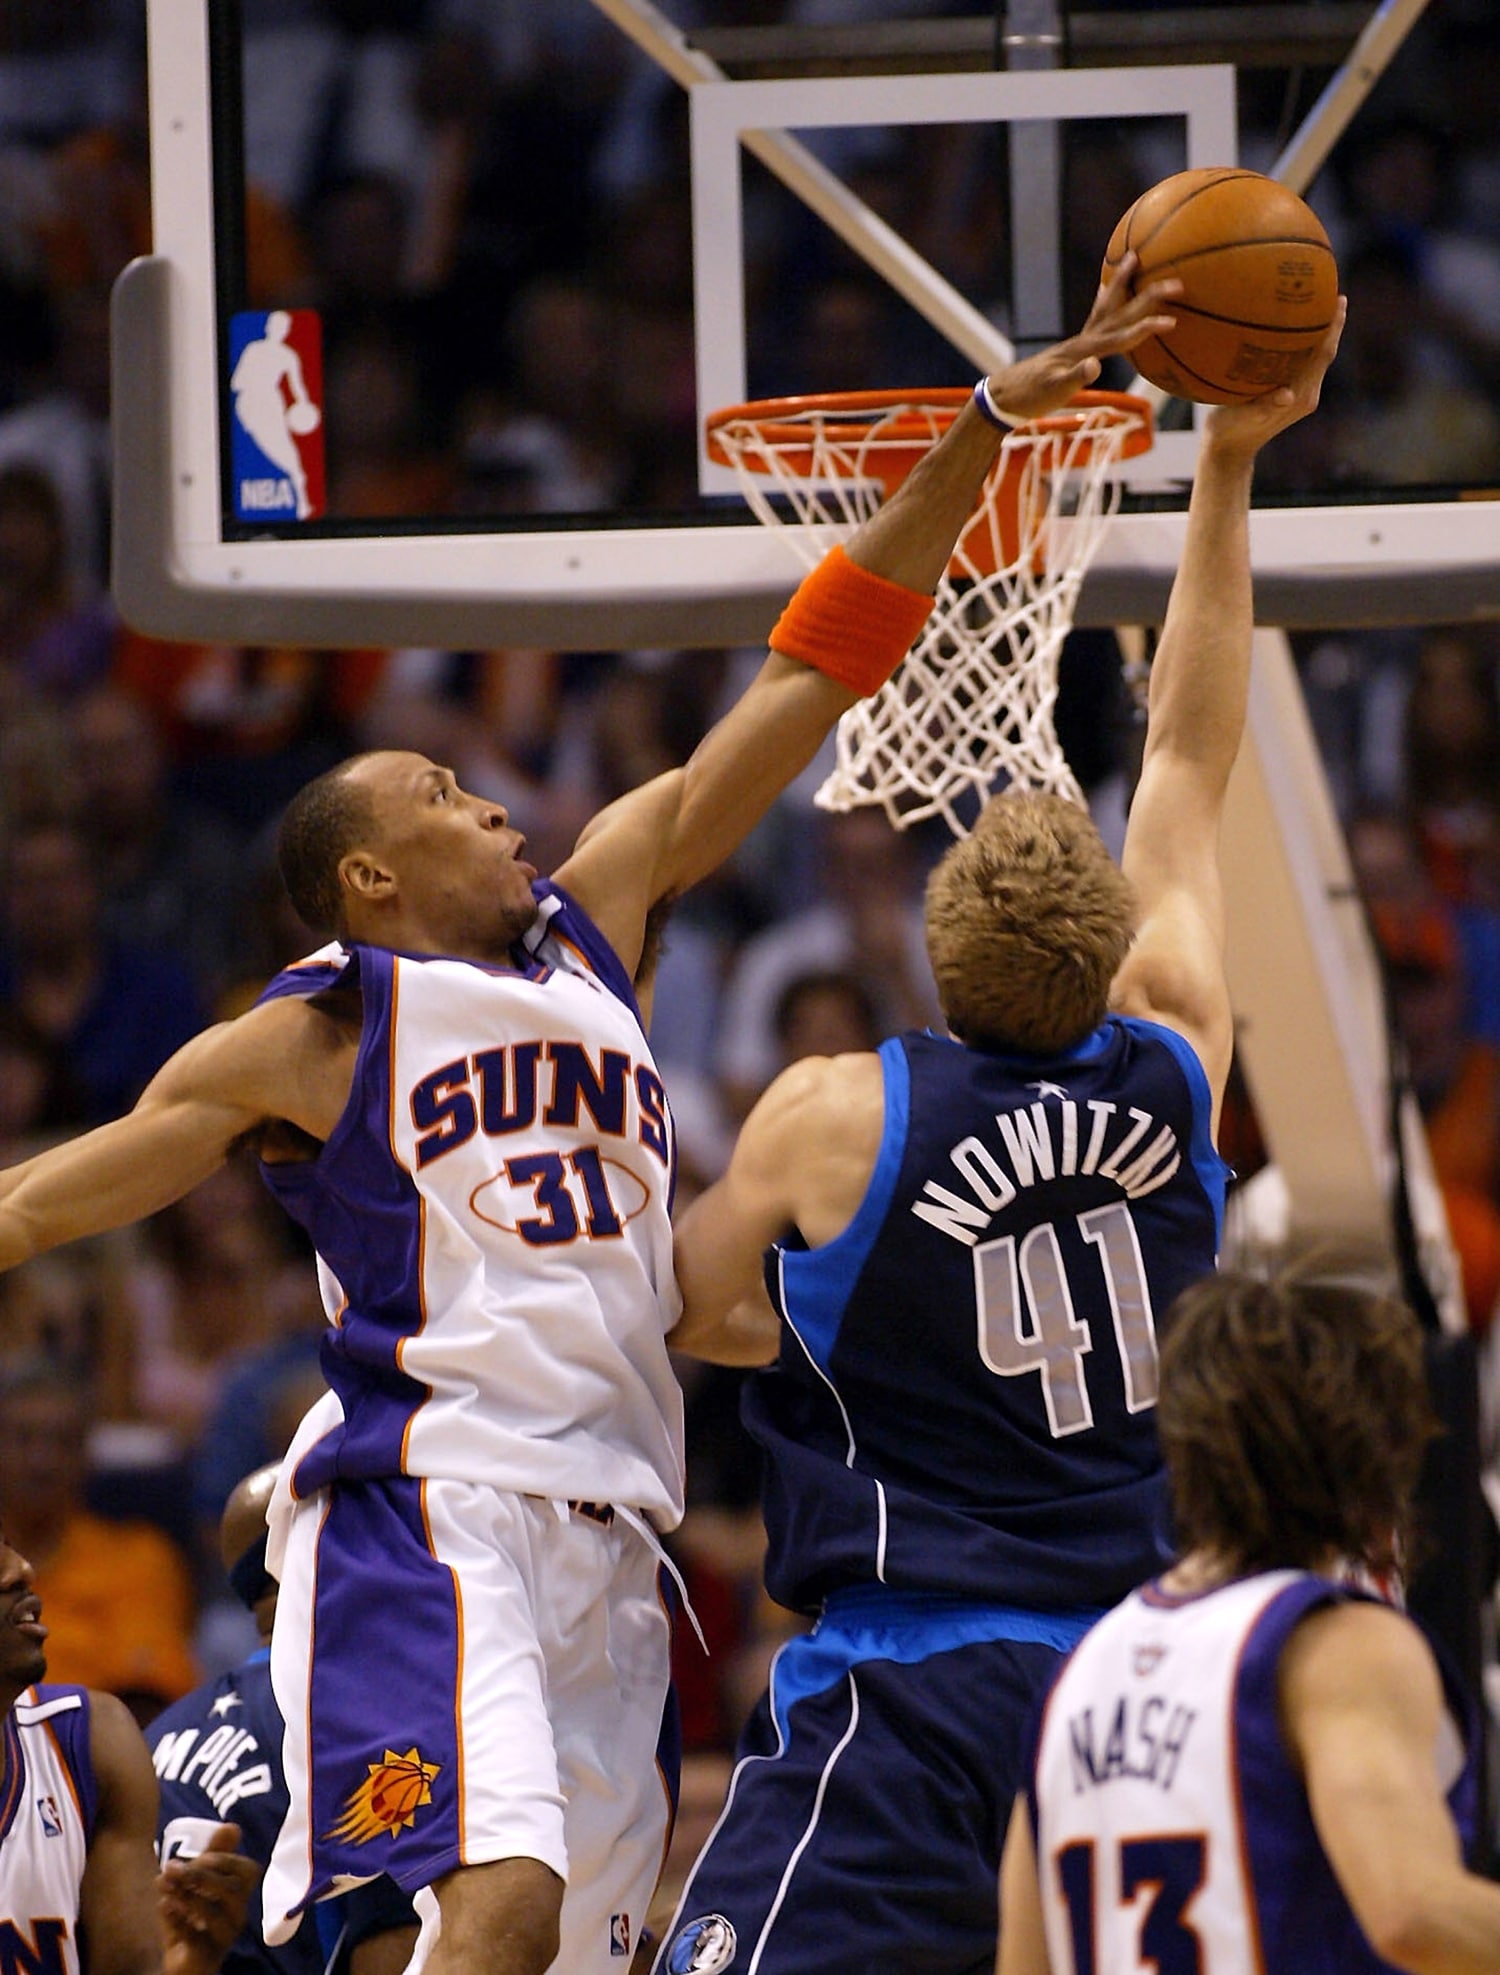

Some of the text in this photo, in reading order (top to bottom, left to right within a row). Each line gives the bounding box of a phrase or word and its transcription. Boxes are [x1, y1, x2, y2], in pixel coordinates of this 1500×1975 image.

[241, 477, 295, 510] NBA
[409, 1039, 668, 1172] SUNS
[503, 1144, 624, 1248] 31
[972, 1201, 1160, 1439] 41
[1068, 1696, 1196, 1794] NASH
[1055, 1831, 1209, 1975] 13
